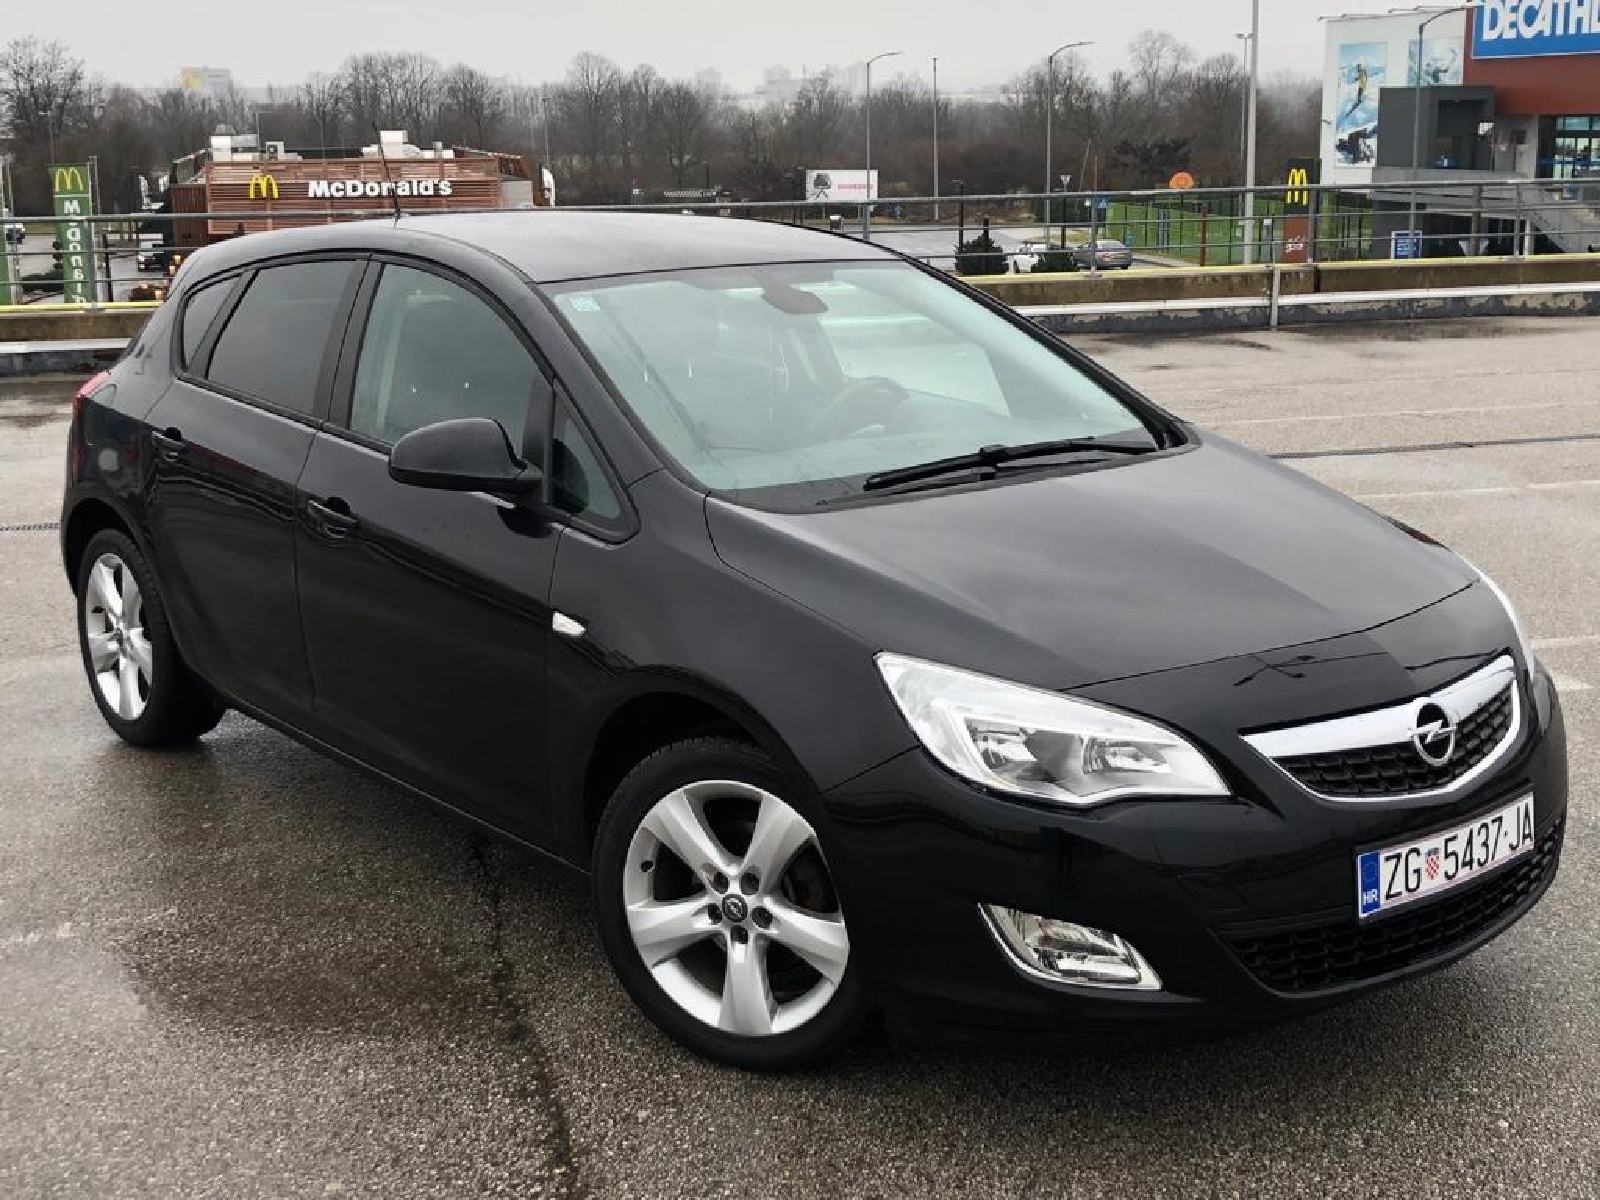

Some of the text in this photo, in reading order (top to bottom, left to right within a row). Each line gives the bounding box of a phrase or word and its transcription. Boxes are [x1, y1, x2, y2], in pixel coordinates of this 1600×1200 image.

[308, 179, 453, 198] McDonald's
[1384, 847, 1421, 900] ZG
[1363, 889, 1378, 905] HR
